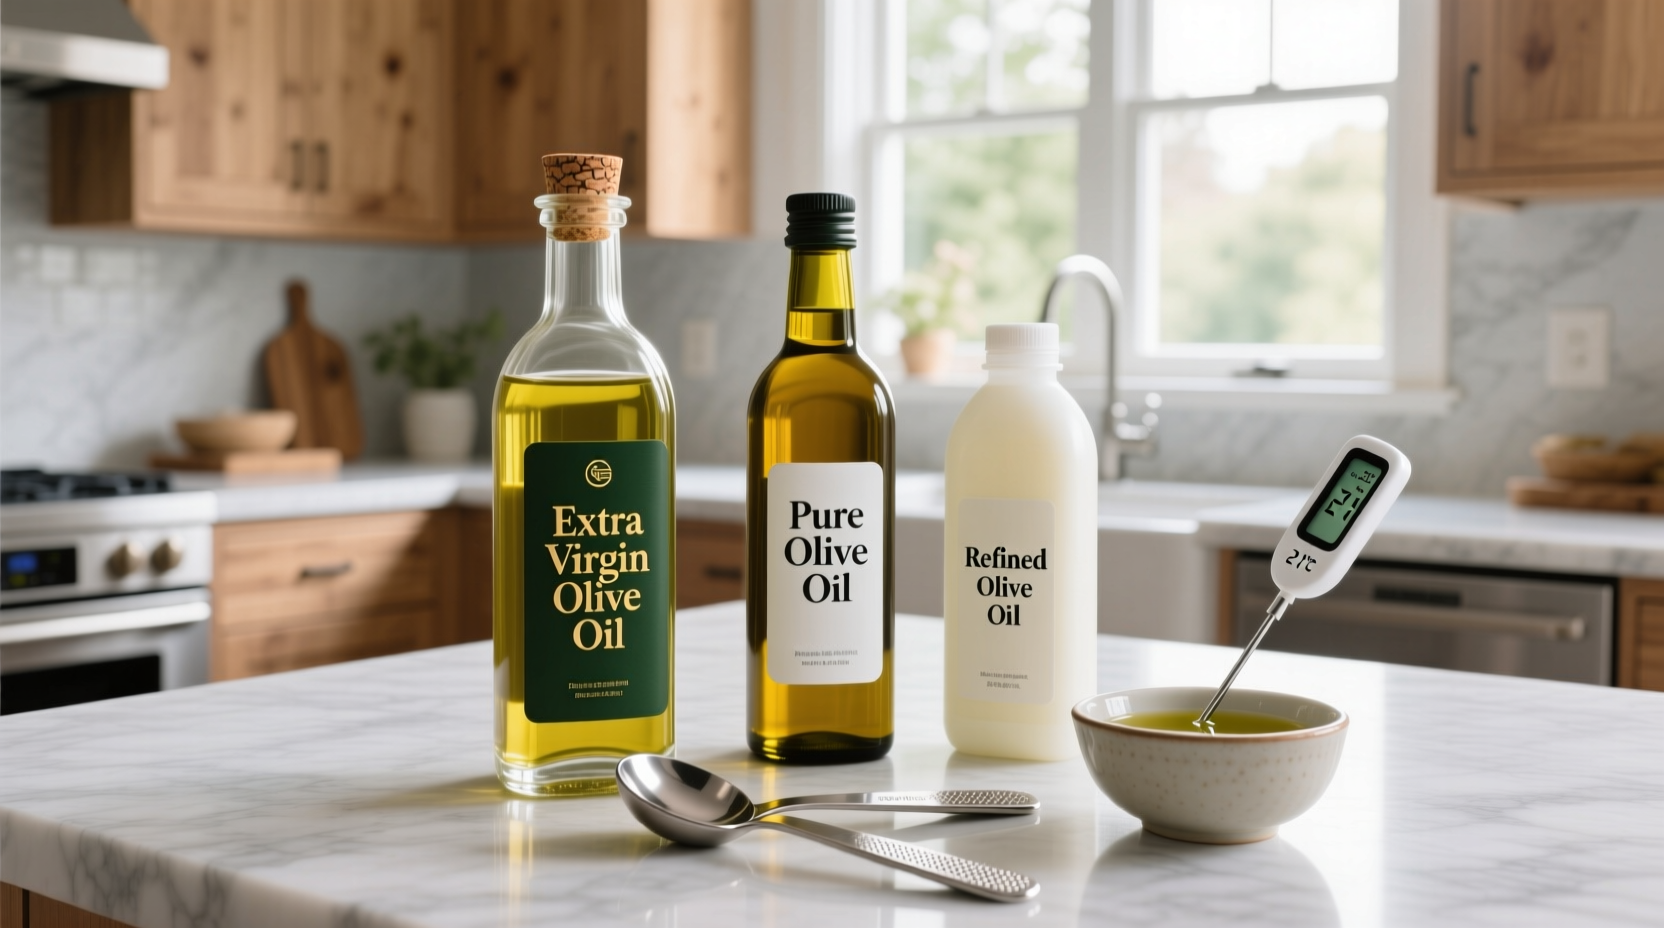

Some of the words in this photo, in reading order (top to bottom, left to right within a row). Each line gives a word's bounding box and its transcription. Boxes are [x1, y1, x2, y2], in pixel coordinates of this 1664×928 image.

[552, 505, 645, 537] Extra
[789, 500, 864, 530] Pure
[544, 542, 650, 585] Virgin
[784, 535, 869, 567] Olive
[965, 546, 1048, 570] Refined
[553, 580, 641, 614] Olive
[802, 572, 853, 604] Oil
[976, 575, 1033, 598] Olive
[987, 604, 1021, 626] Oil
[573, 617, 625, 651] Oil
